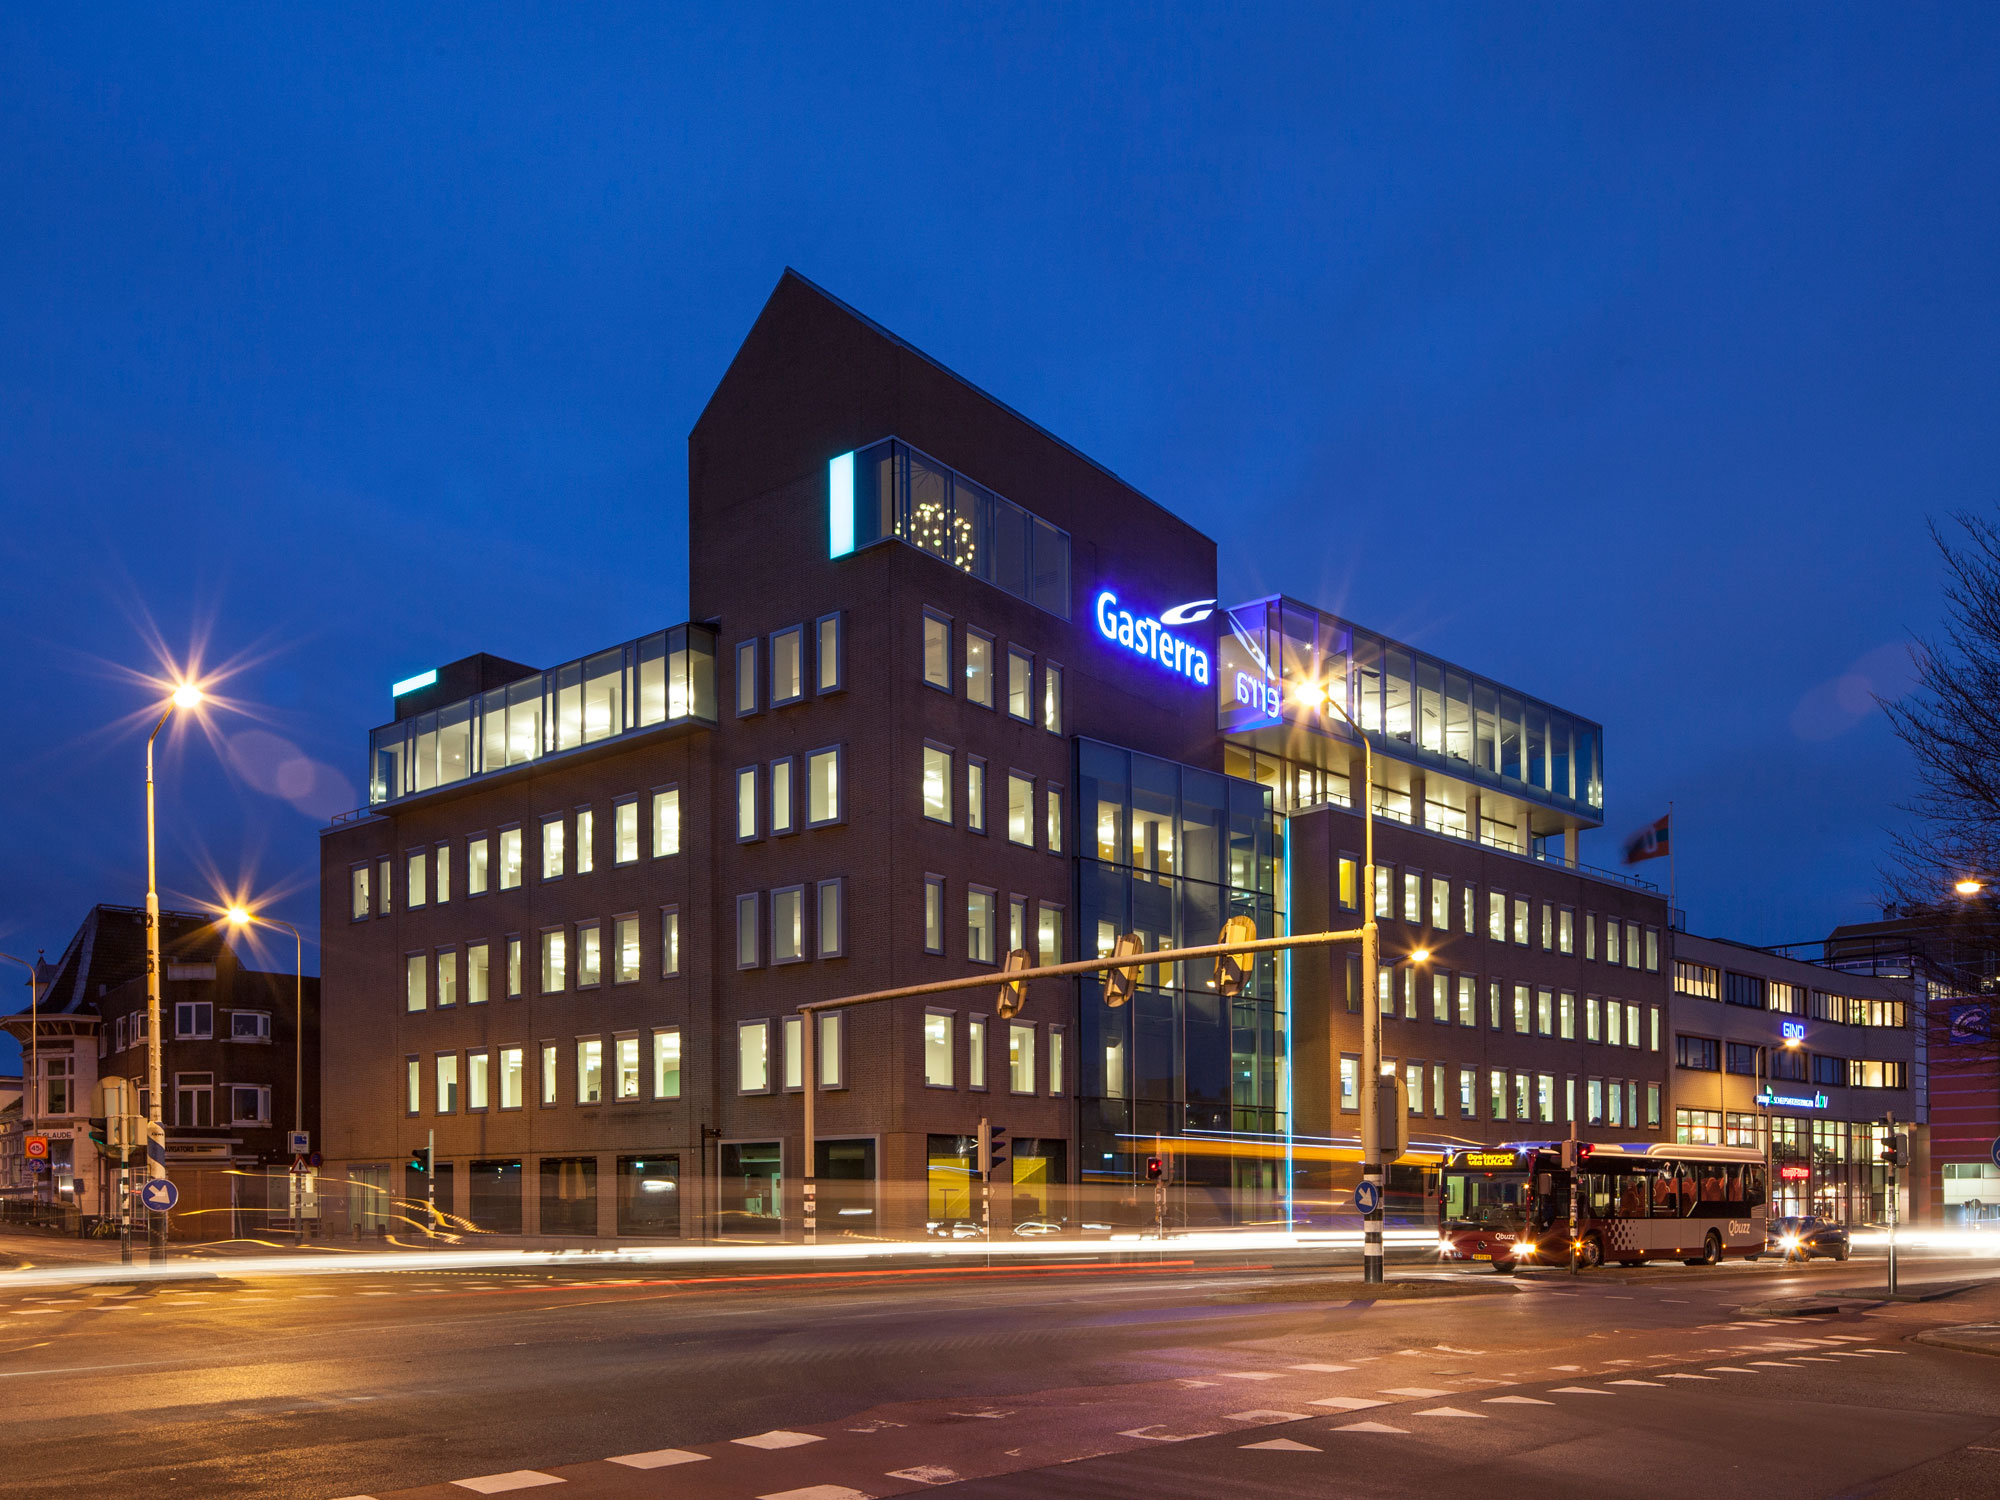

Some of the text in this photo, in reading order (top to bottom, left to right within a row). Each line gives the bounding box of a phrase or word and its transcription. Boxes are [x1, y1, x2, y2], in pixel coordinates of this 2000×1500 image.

[1097, 591, 1209, 685] GasTerra
[1783, 1021, 1804, 1040] GINO
[1495, 1232, 1515, 1241] Qbuzz
[1728, 1219, 1751, 1236] Qbuzz
